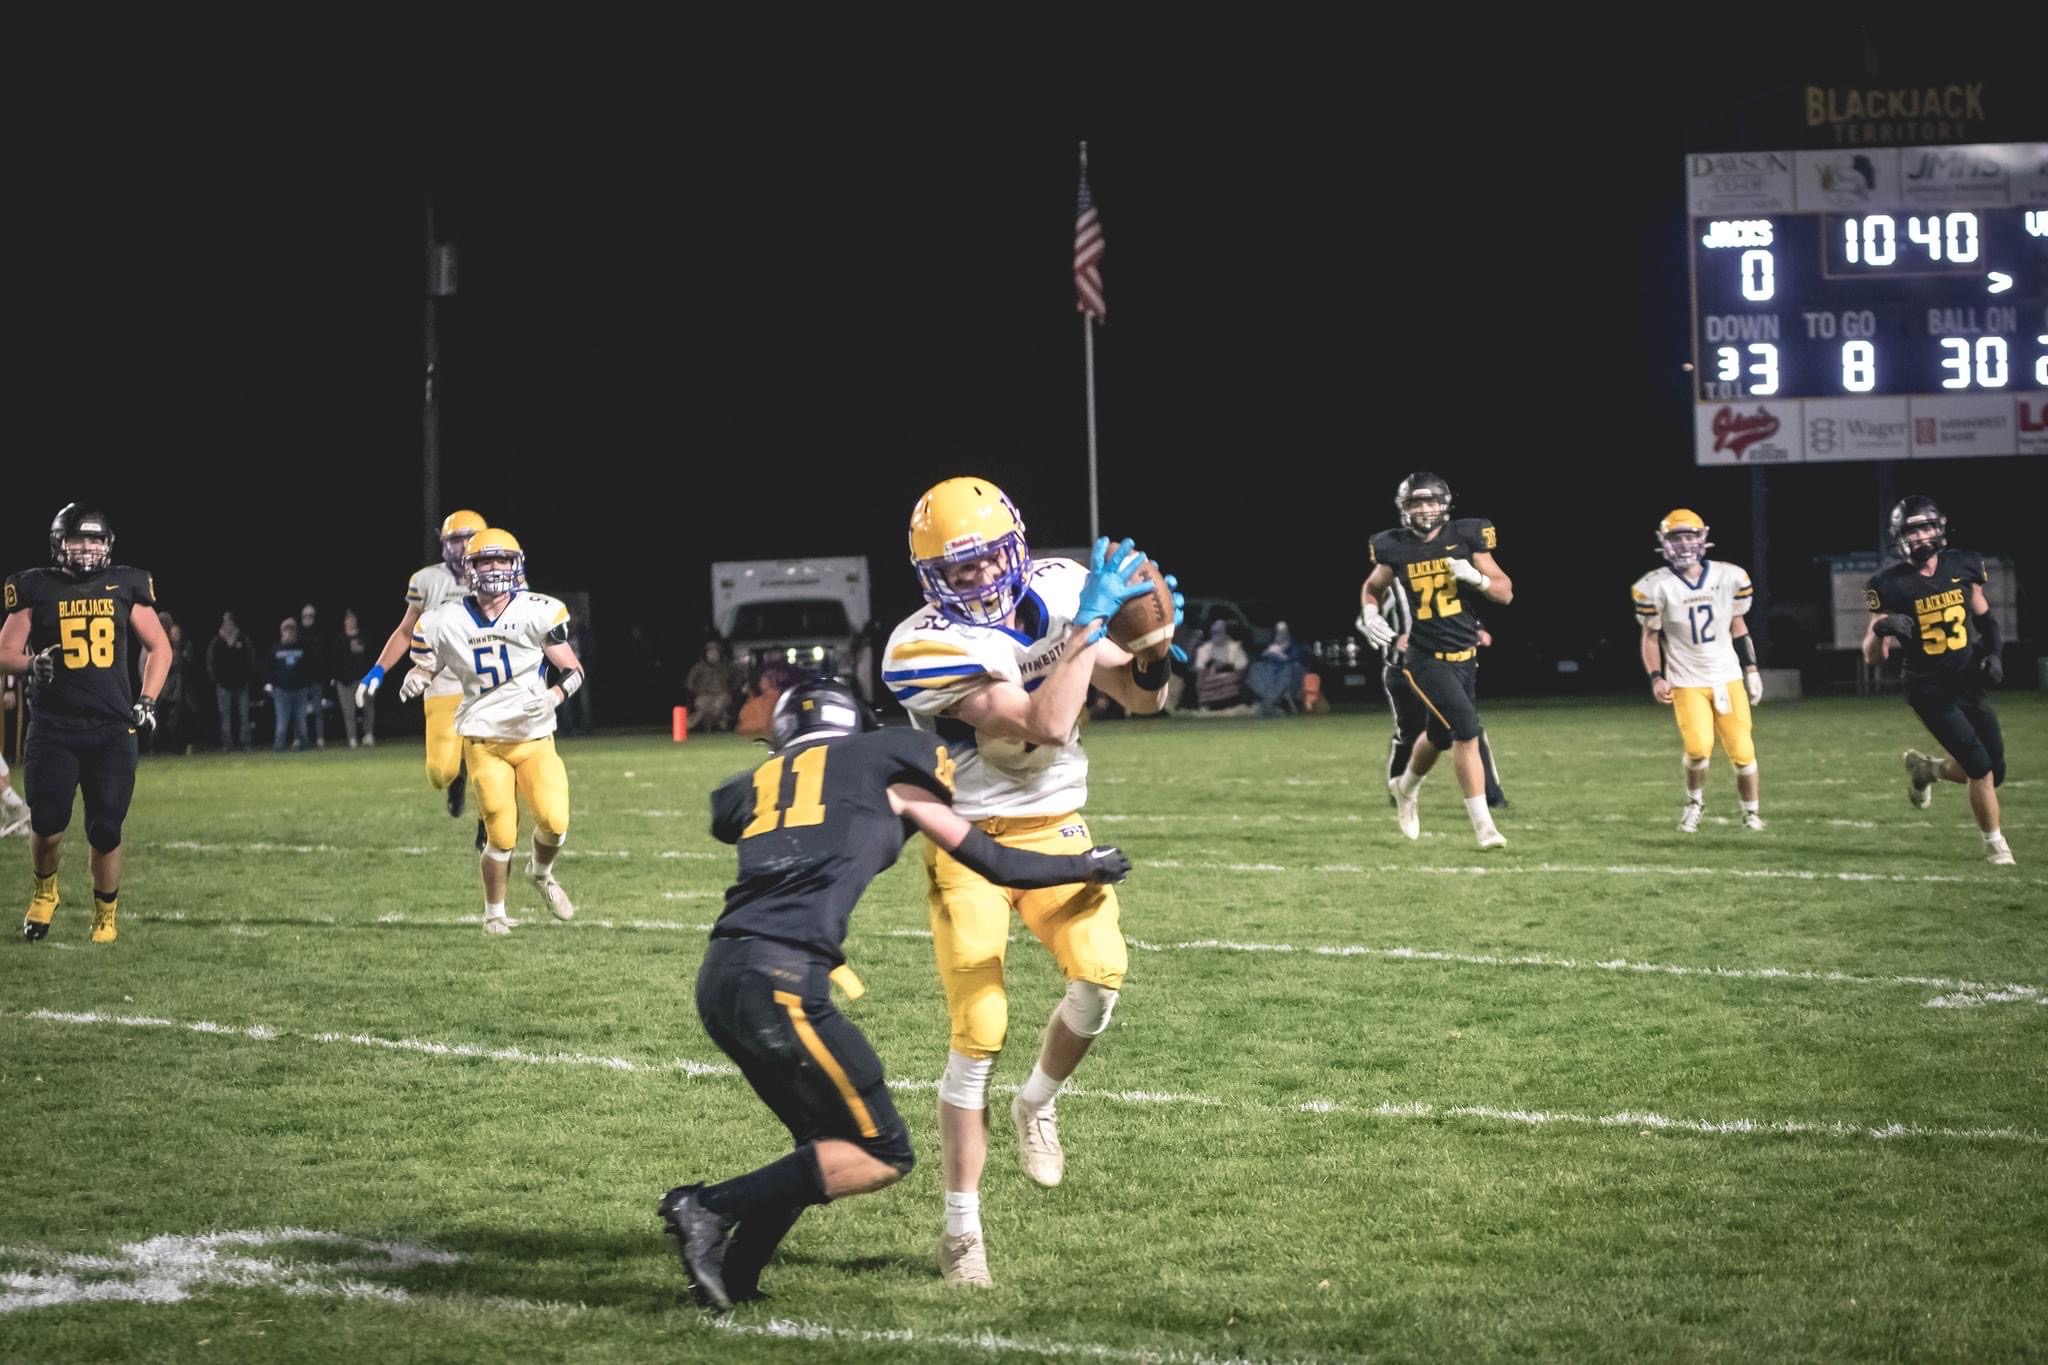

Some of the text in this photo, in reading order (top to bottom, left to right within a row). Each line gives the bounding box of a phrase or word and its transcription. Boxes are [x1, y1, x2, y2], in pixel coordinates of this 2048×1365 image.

[1805, 83, 1985, 126] BLACKJACK
[1834, 122, 1967, 143] TERRITORY
[1741, 250, 1775, 301] 0
[1705, 314, 1780, 342] DOWN
[1803, 310, 1876, 339] TO GO
[1928, 308, 1981, 335] BALL
[1985, 306, 2017, 332] ON
[1842, 340, 1876, 392] 8
[1940, 336, 2009, 389] 30
[58, 598, 115, 618] BLACKJACKS
[1410, 573, 1463, 620] 72
[1914, 588, 1966, 615] BLACKJACKS
[60, 617, 115, 669] 58
[1688, 604, 1716, 645] 12
[1917, 604, 1968, 655] 53
[472, 643, 513, 695] 51
[741, 744, 829, 839] 11
